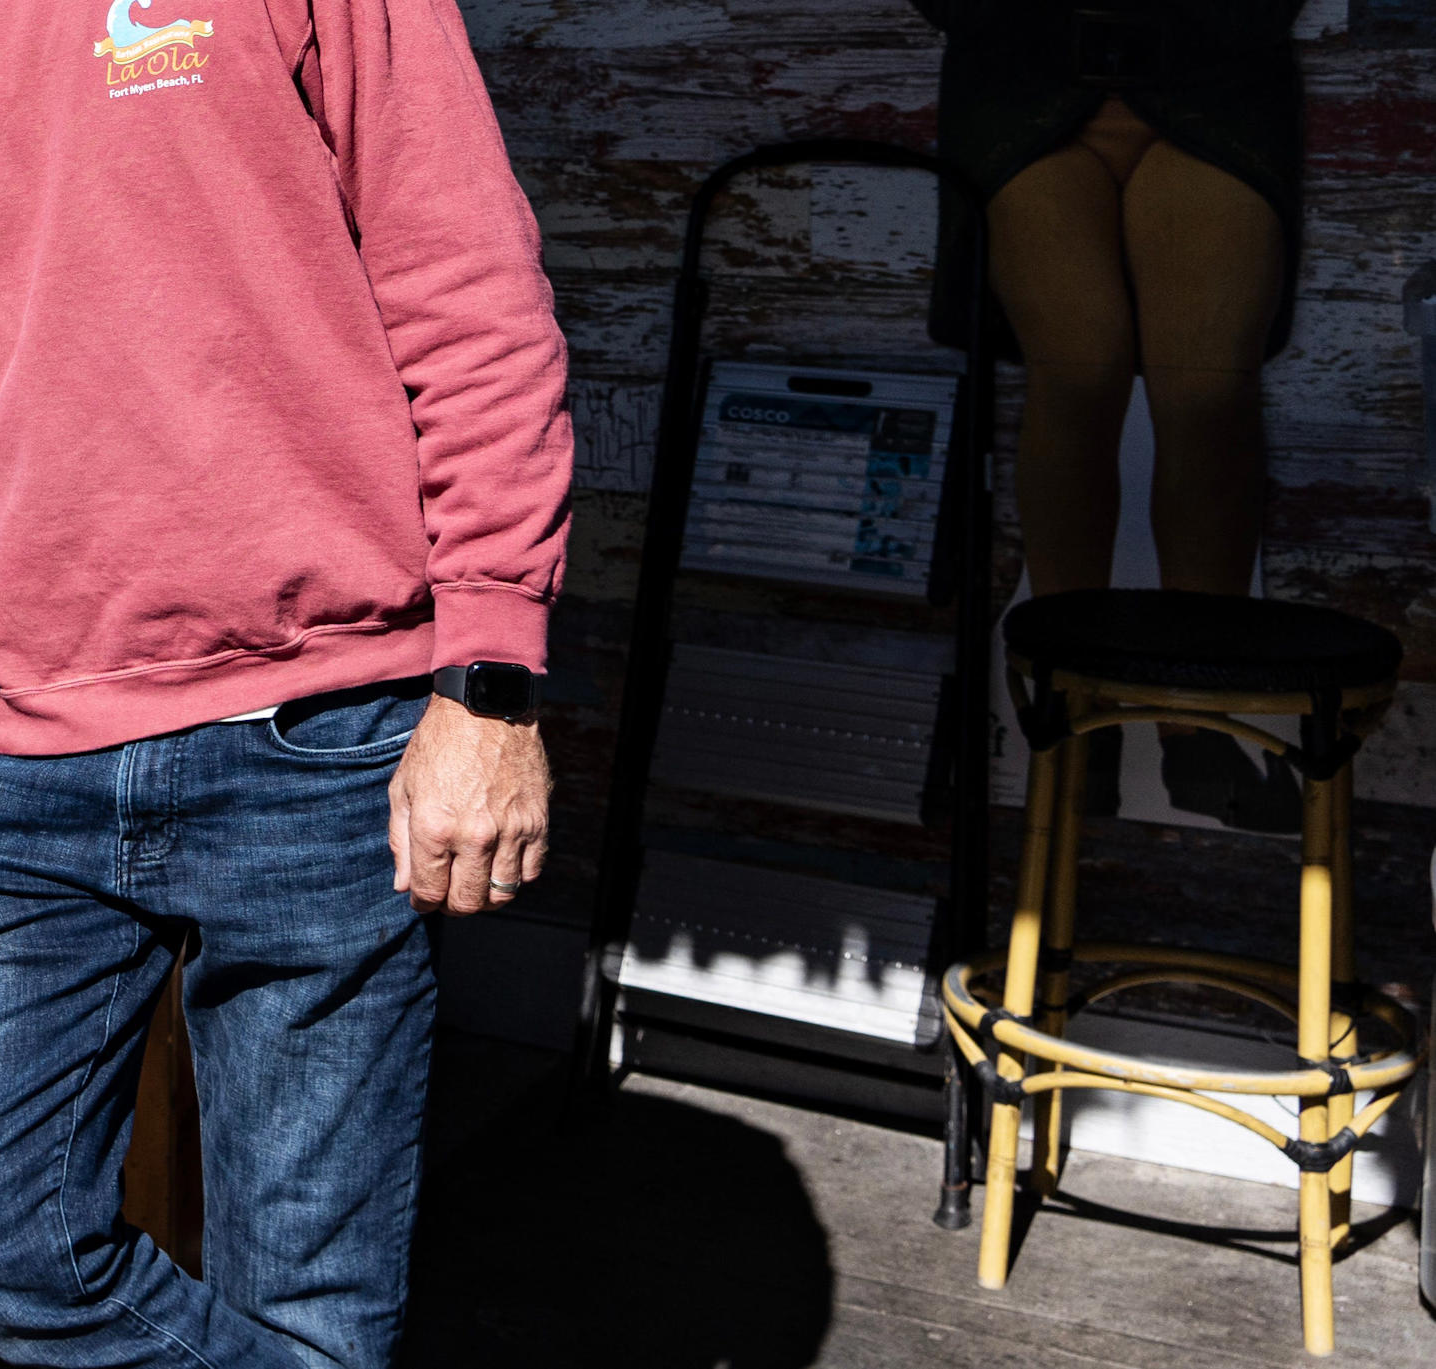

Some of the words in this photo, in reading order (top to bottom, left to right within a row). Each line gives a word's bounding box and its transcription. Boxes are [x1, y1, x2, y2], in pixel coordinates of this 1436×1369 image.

[106, 61, 144, 86] La
[147, 47, 210, 76] Ola
[109, 86, 129, 99] Fort
[130, 82, 156, 95] Myers
[157, 75, 189, 90] Beach,
[191, 73, 204, 84] FL
[727, 406, 791, 423] COSCO
